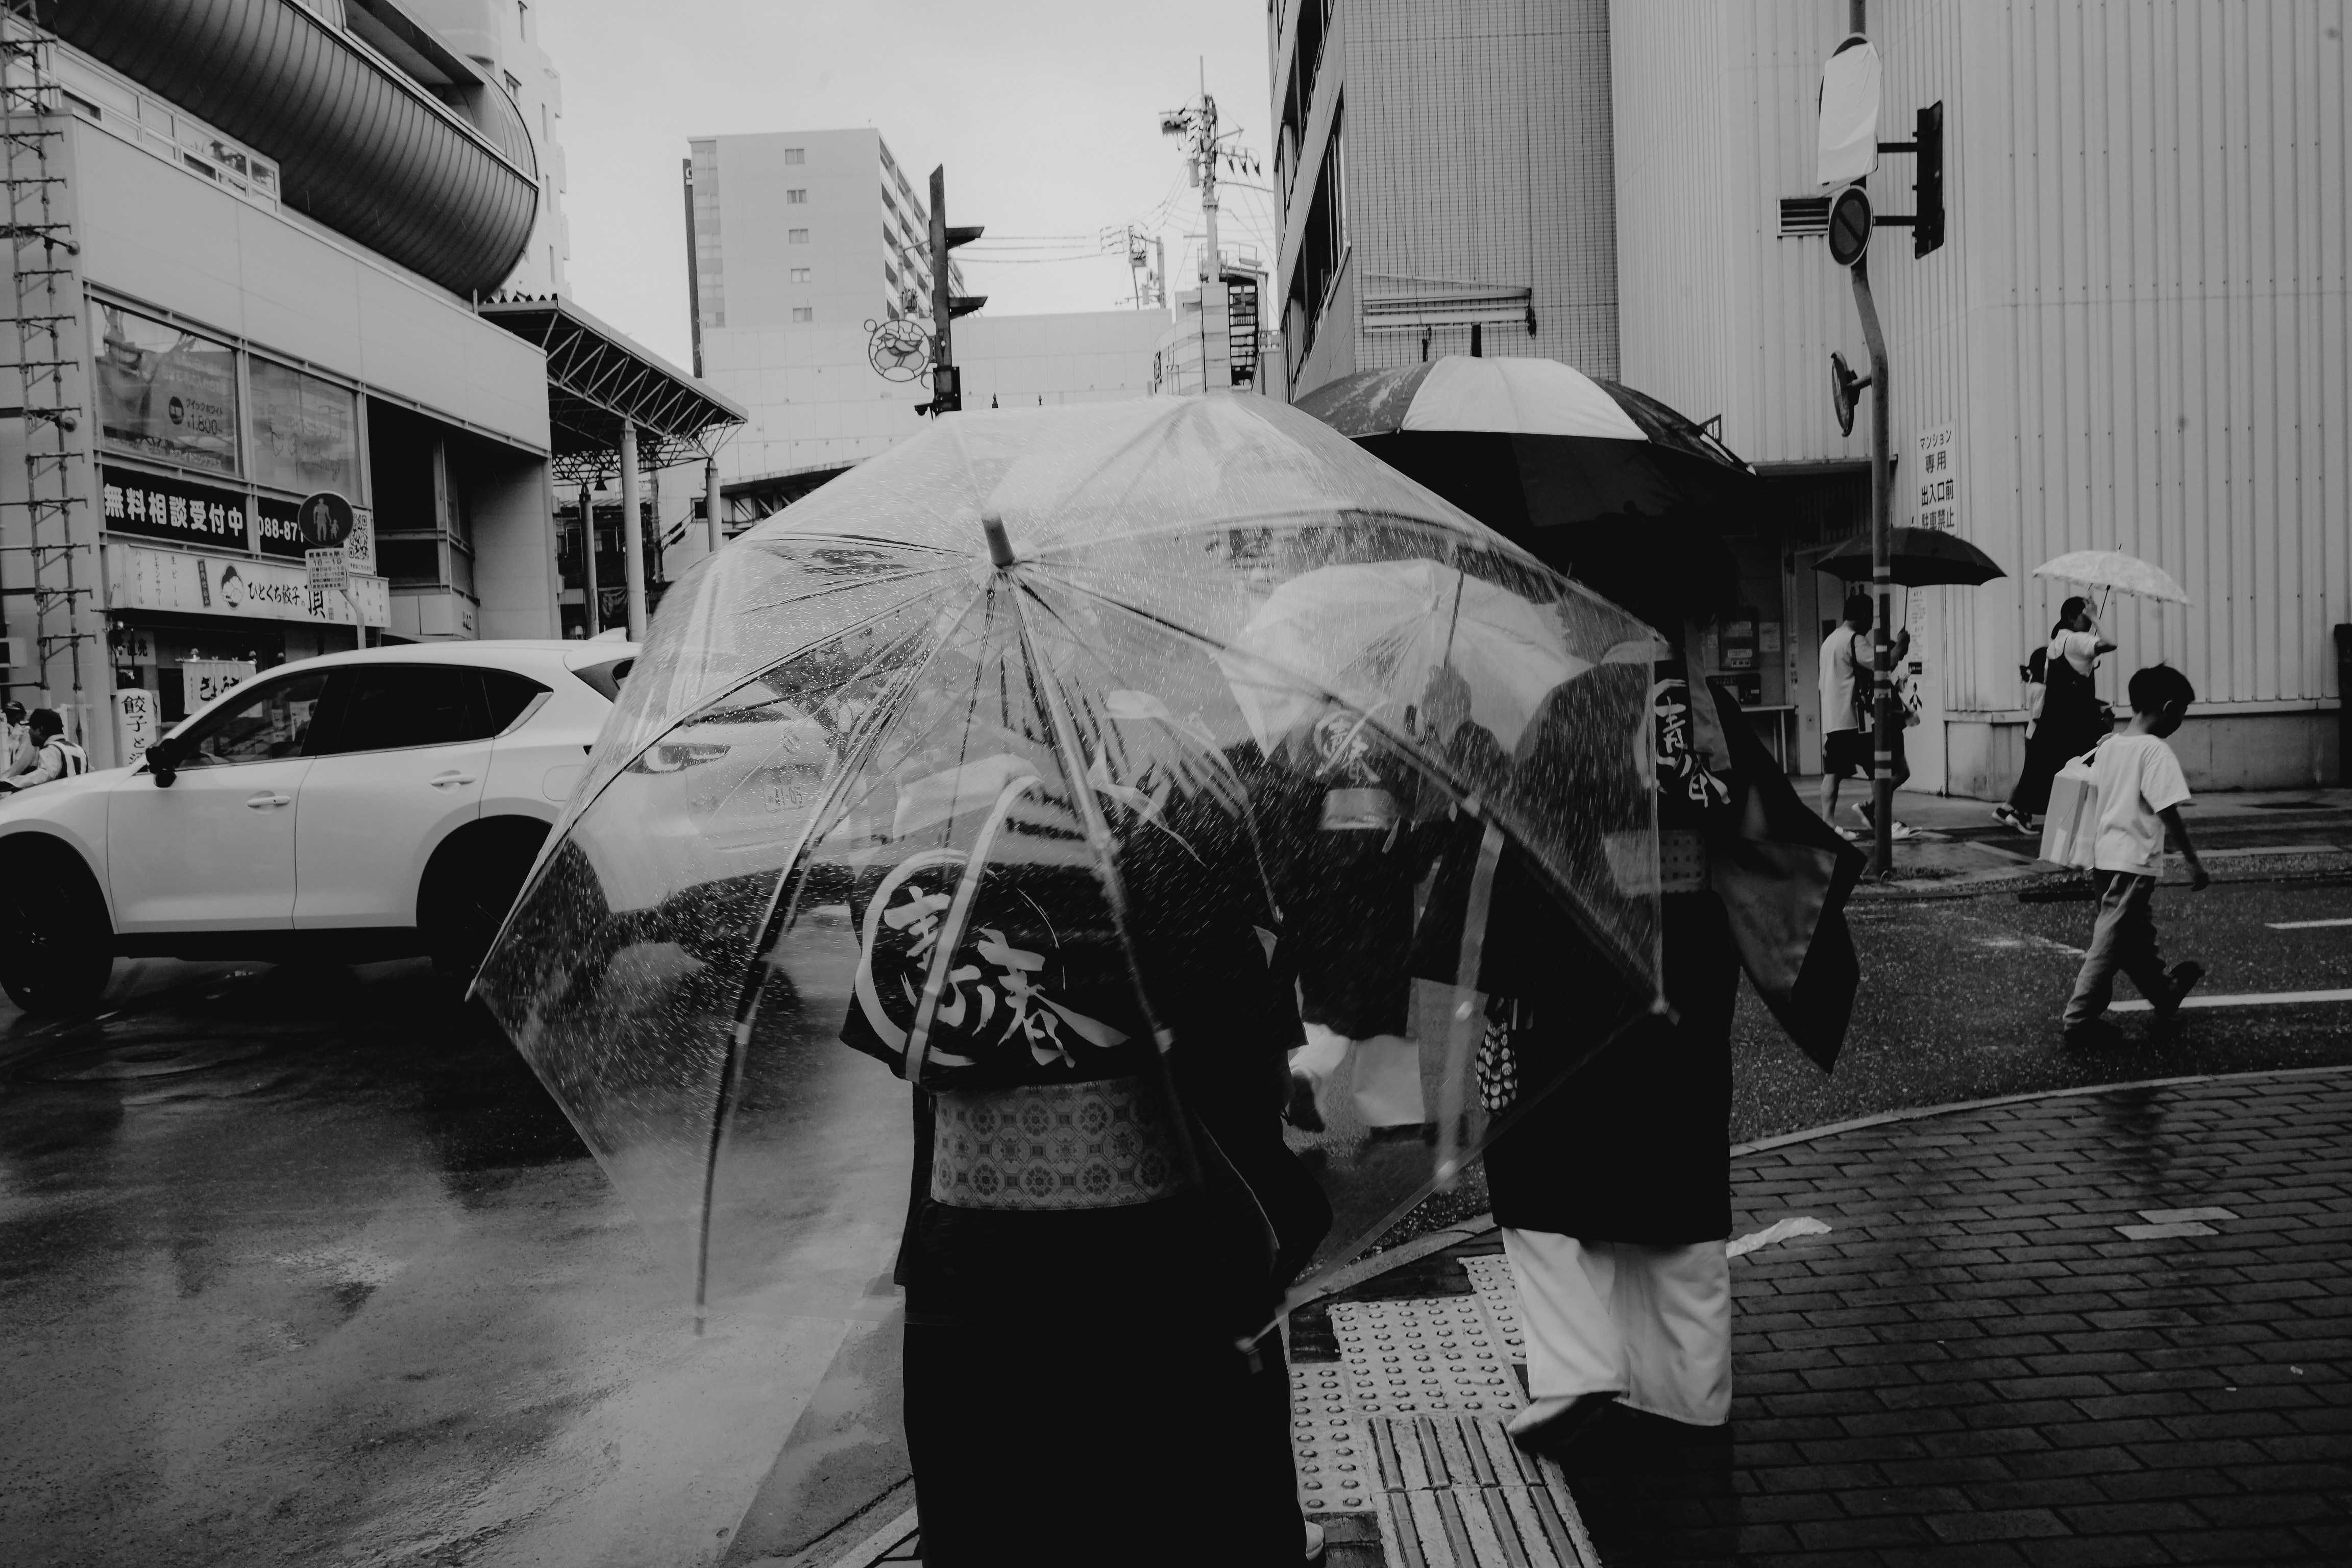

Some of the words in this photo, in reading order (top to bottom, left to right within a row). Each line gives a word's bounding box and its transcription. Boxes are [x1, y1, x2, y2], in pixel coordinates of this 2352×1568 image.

[1920, 430, 1951, 451] マンション
[1925, 450, 1947, 474] 専用
[1921, 478, 1954, 506] 出入口前
[104, 482, 243, 537] 無料相談受付中
[1921, 506, 1954, 531] 駐車禁止
[136, 551, 144, 604] ハイボール
[171, 555, 179, 607] 生ビール
